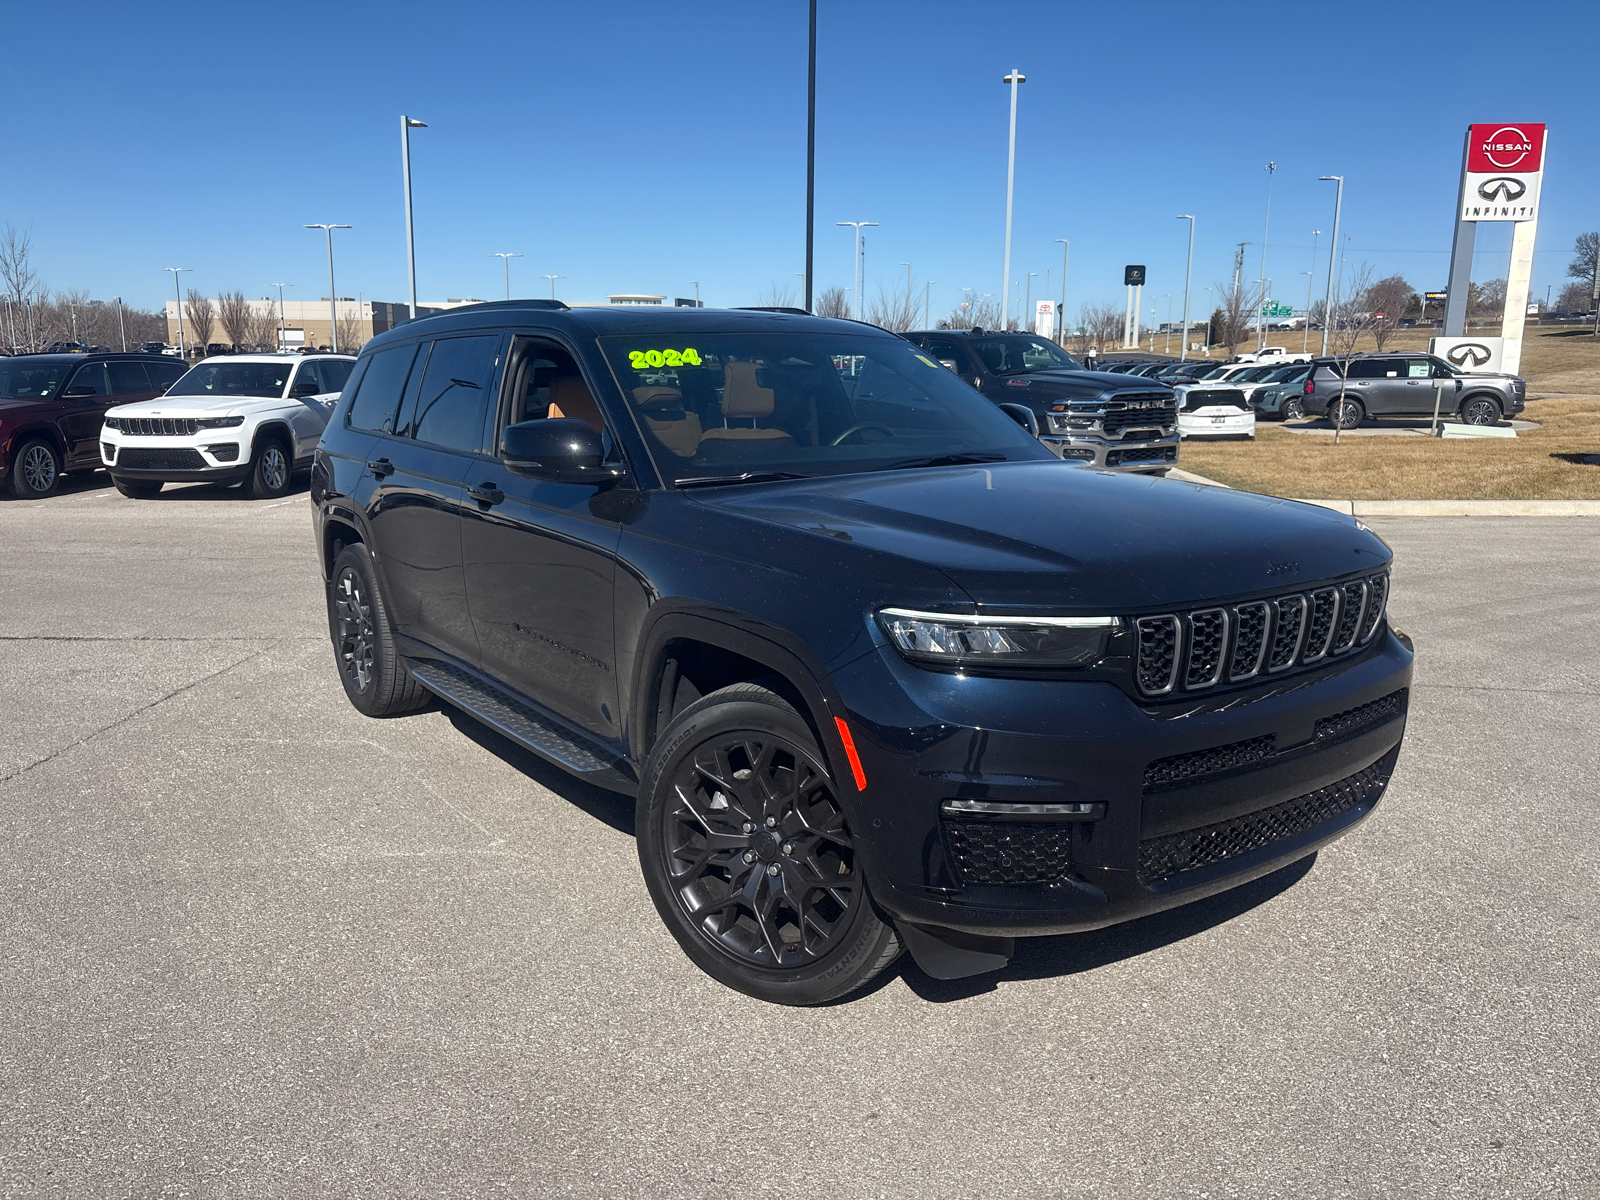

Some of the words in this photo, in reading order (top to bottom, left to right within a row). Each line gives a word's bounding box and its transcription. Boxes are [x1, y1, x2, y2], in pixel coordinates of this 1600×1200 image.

[1482, 143, 1532, 151] NISSAN
[1465, 207, 1534, 216] INFINITI
[628, 347, 703, 369] 2024
[1128, 401, 1164, 410] RAM
[817, 912, 876, 982] NTINENTAL
